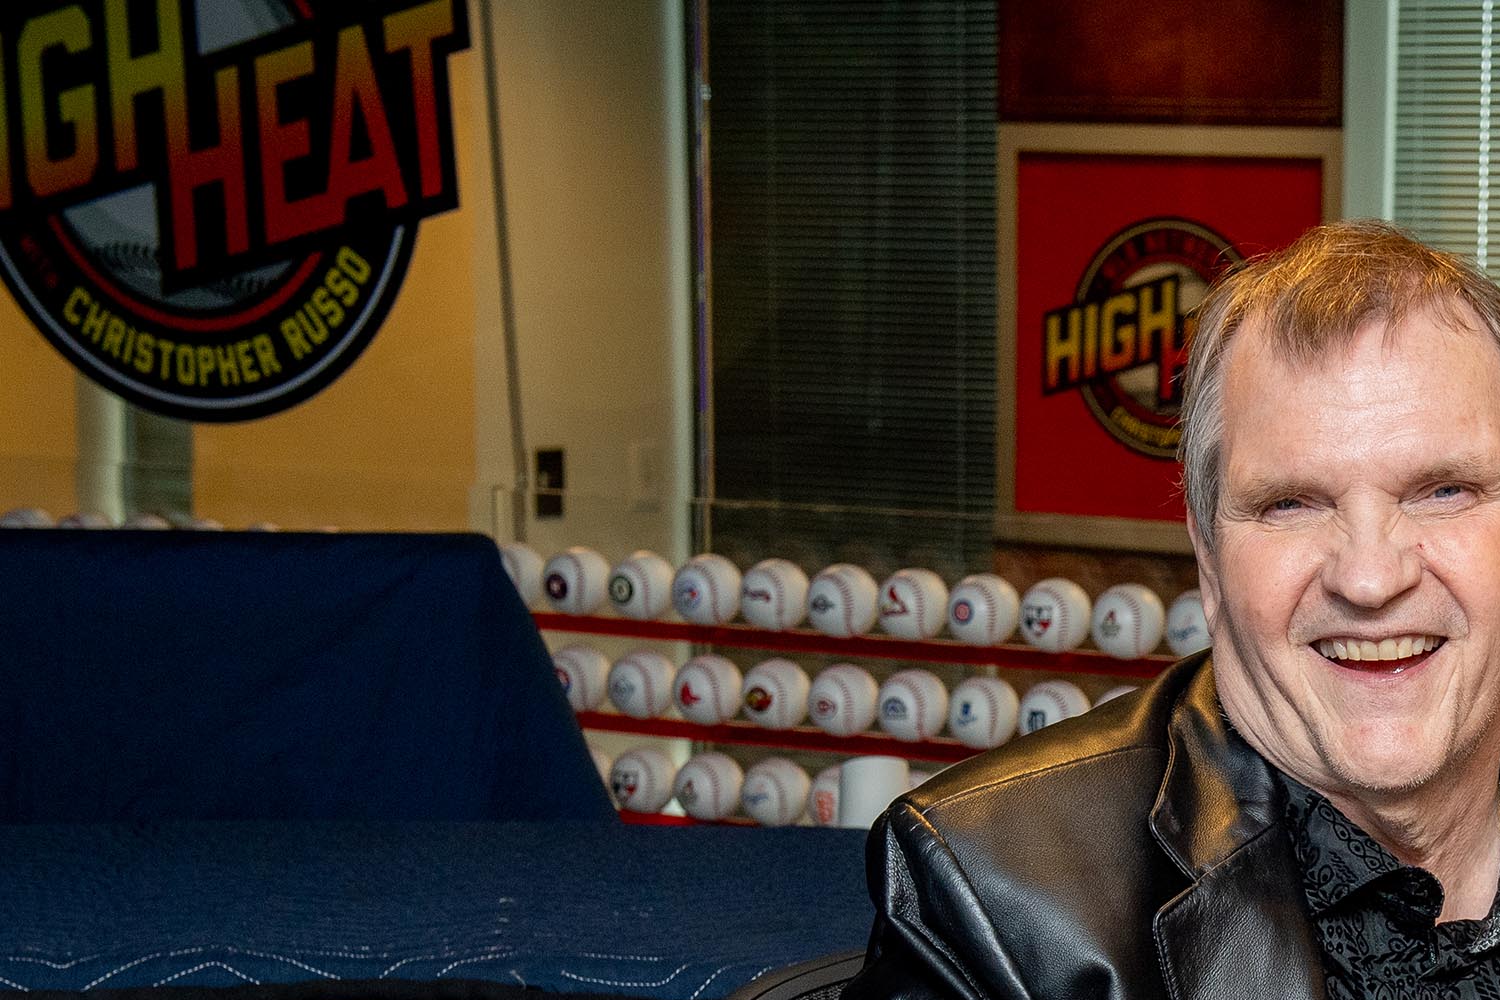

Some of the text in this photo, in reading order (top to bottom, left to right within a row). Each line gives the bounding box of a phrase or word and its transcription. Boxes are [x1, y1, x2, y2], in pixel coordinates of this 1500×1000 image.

[160, 0, 456, 271] HEAT
[62, 246, 373, 387] CHRISTOPHER RUSSO
[1046, 279, 1177, 389] HIGH
